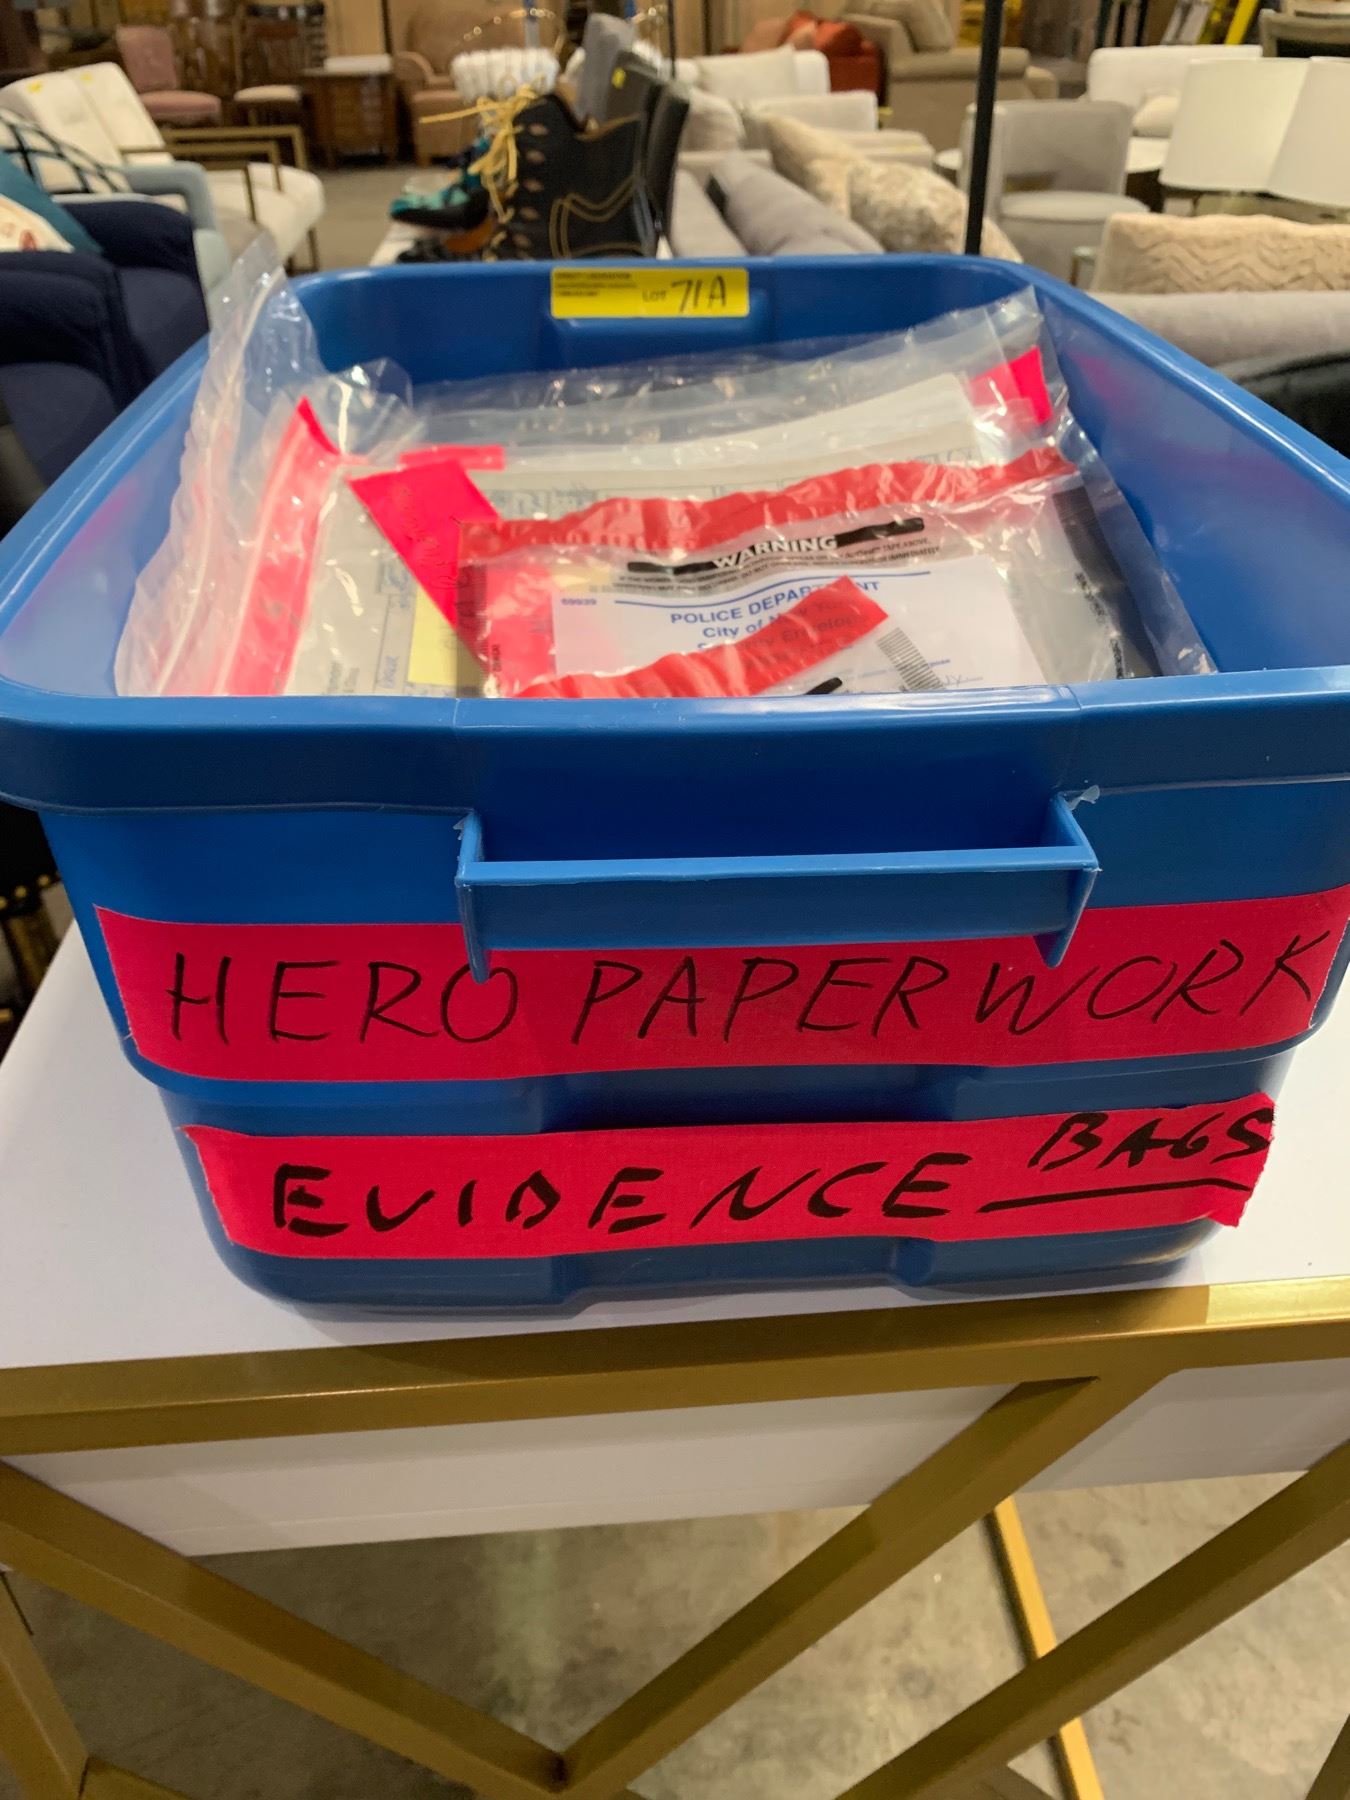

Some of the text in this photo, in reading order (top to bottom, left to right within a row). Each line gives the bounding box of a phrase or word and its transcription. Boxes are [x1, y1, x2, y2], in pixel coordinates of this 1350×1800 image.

[642, 274, 727, 314] LOT 71A
[712, 535, 838, 568] WARNING
[671, 606, 743, 625] POLICE
[748, 580, 880, 616] DEPARNT
[702, 624, 740, 639] City
[746, 619, 764, 633] of
[165, 952, 519, 1045] HERO
[273, 1107, 1275, 1238] EVIDENCE BAGS
